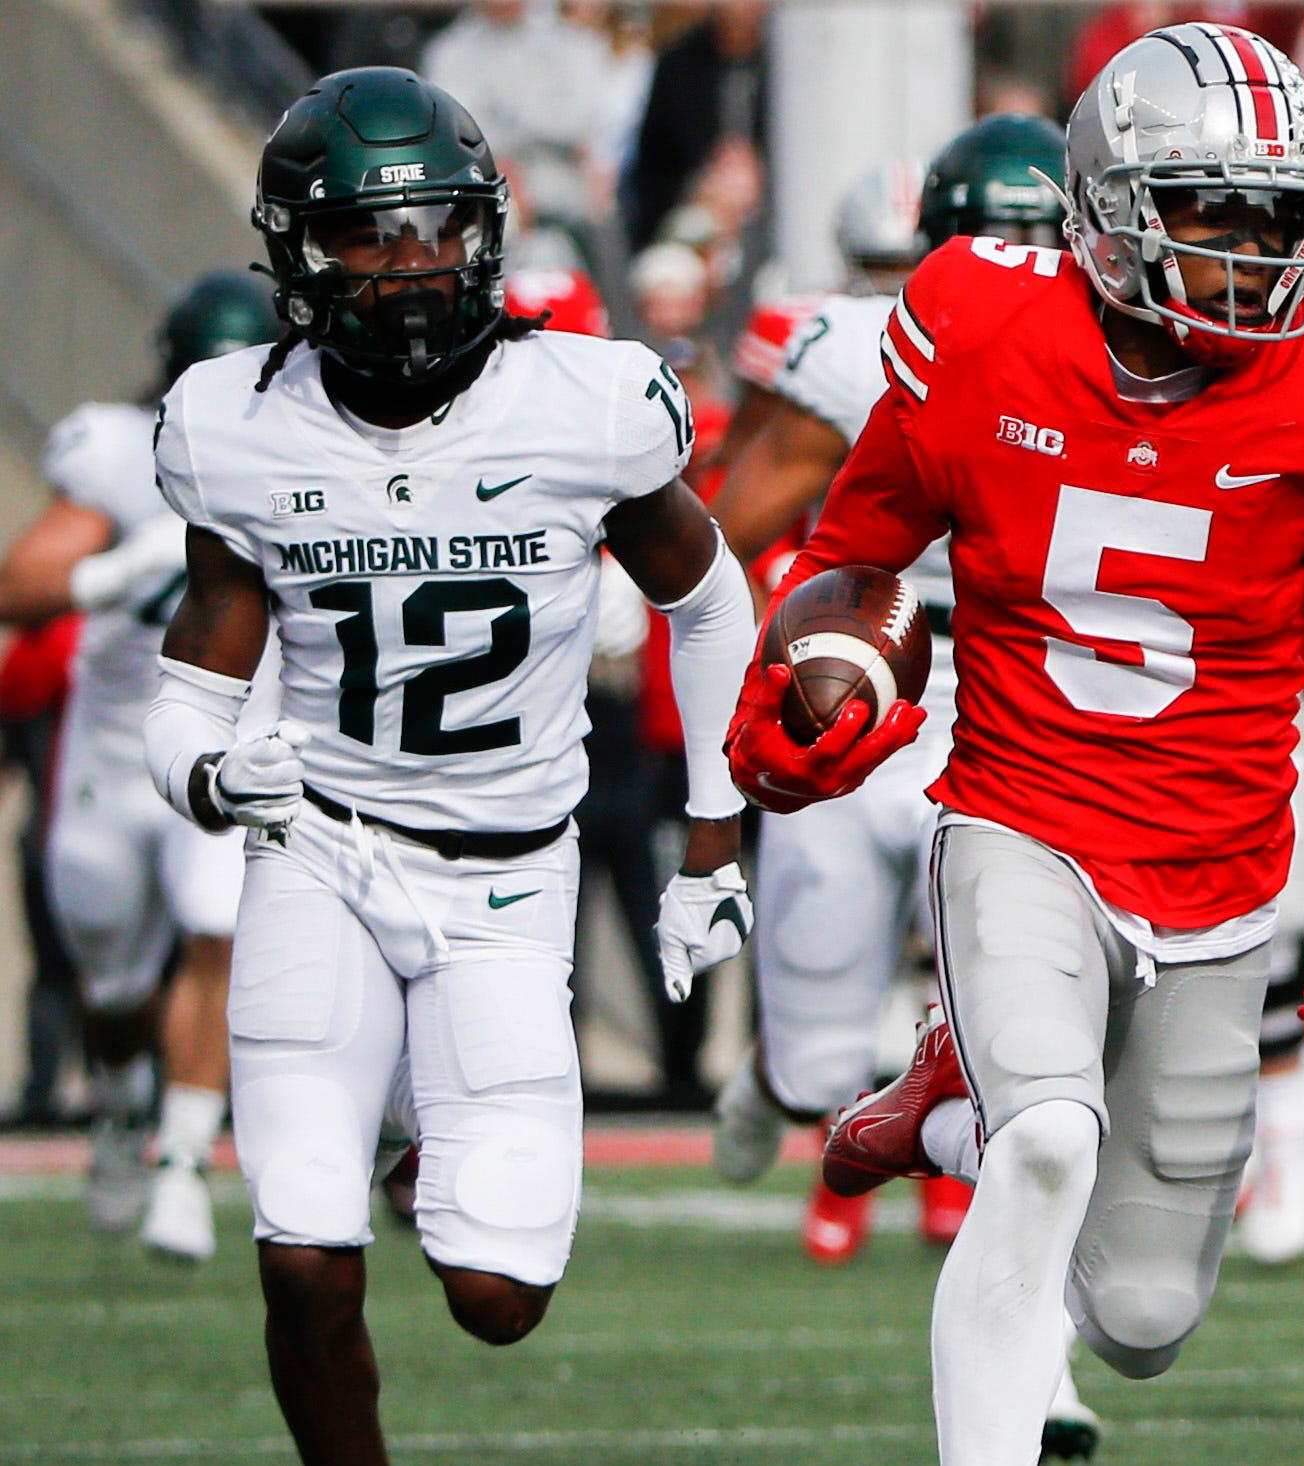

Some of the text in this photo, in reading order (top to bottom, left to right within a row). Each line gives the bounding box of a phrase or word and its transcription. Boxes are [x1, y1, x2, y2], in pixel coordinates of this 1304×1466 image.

[380, 163, 426, 183] STATE
[970, 235, 1063, 278] 5
[272, 528, 551, 574] MICHIGAN STATE
[1040, 484, 1214, 719] 5
[307, 576, 532, 757] 12
